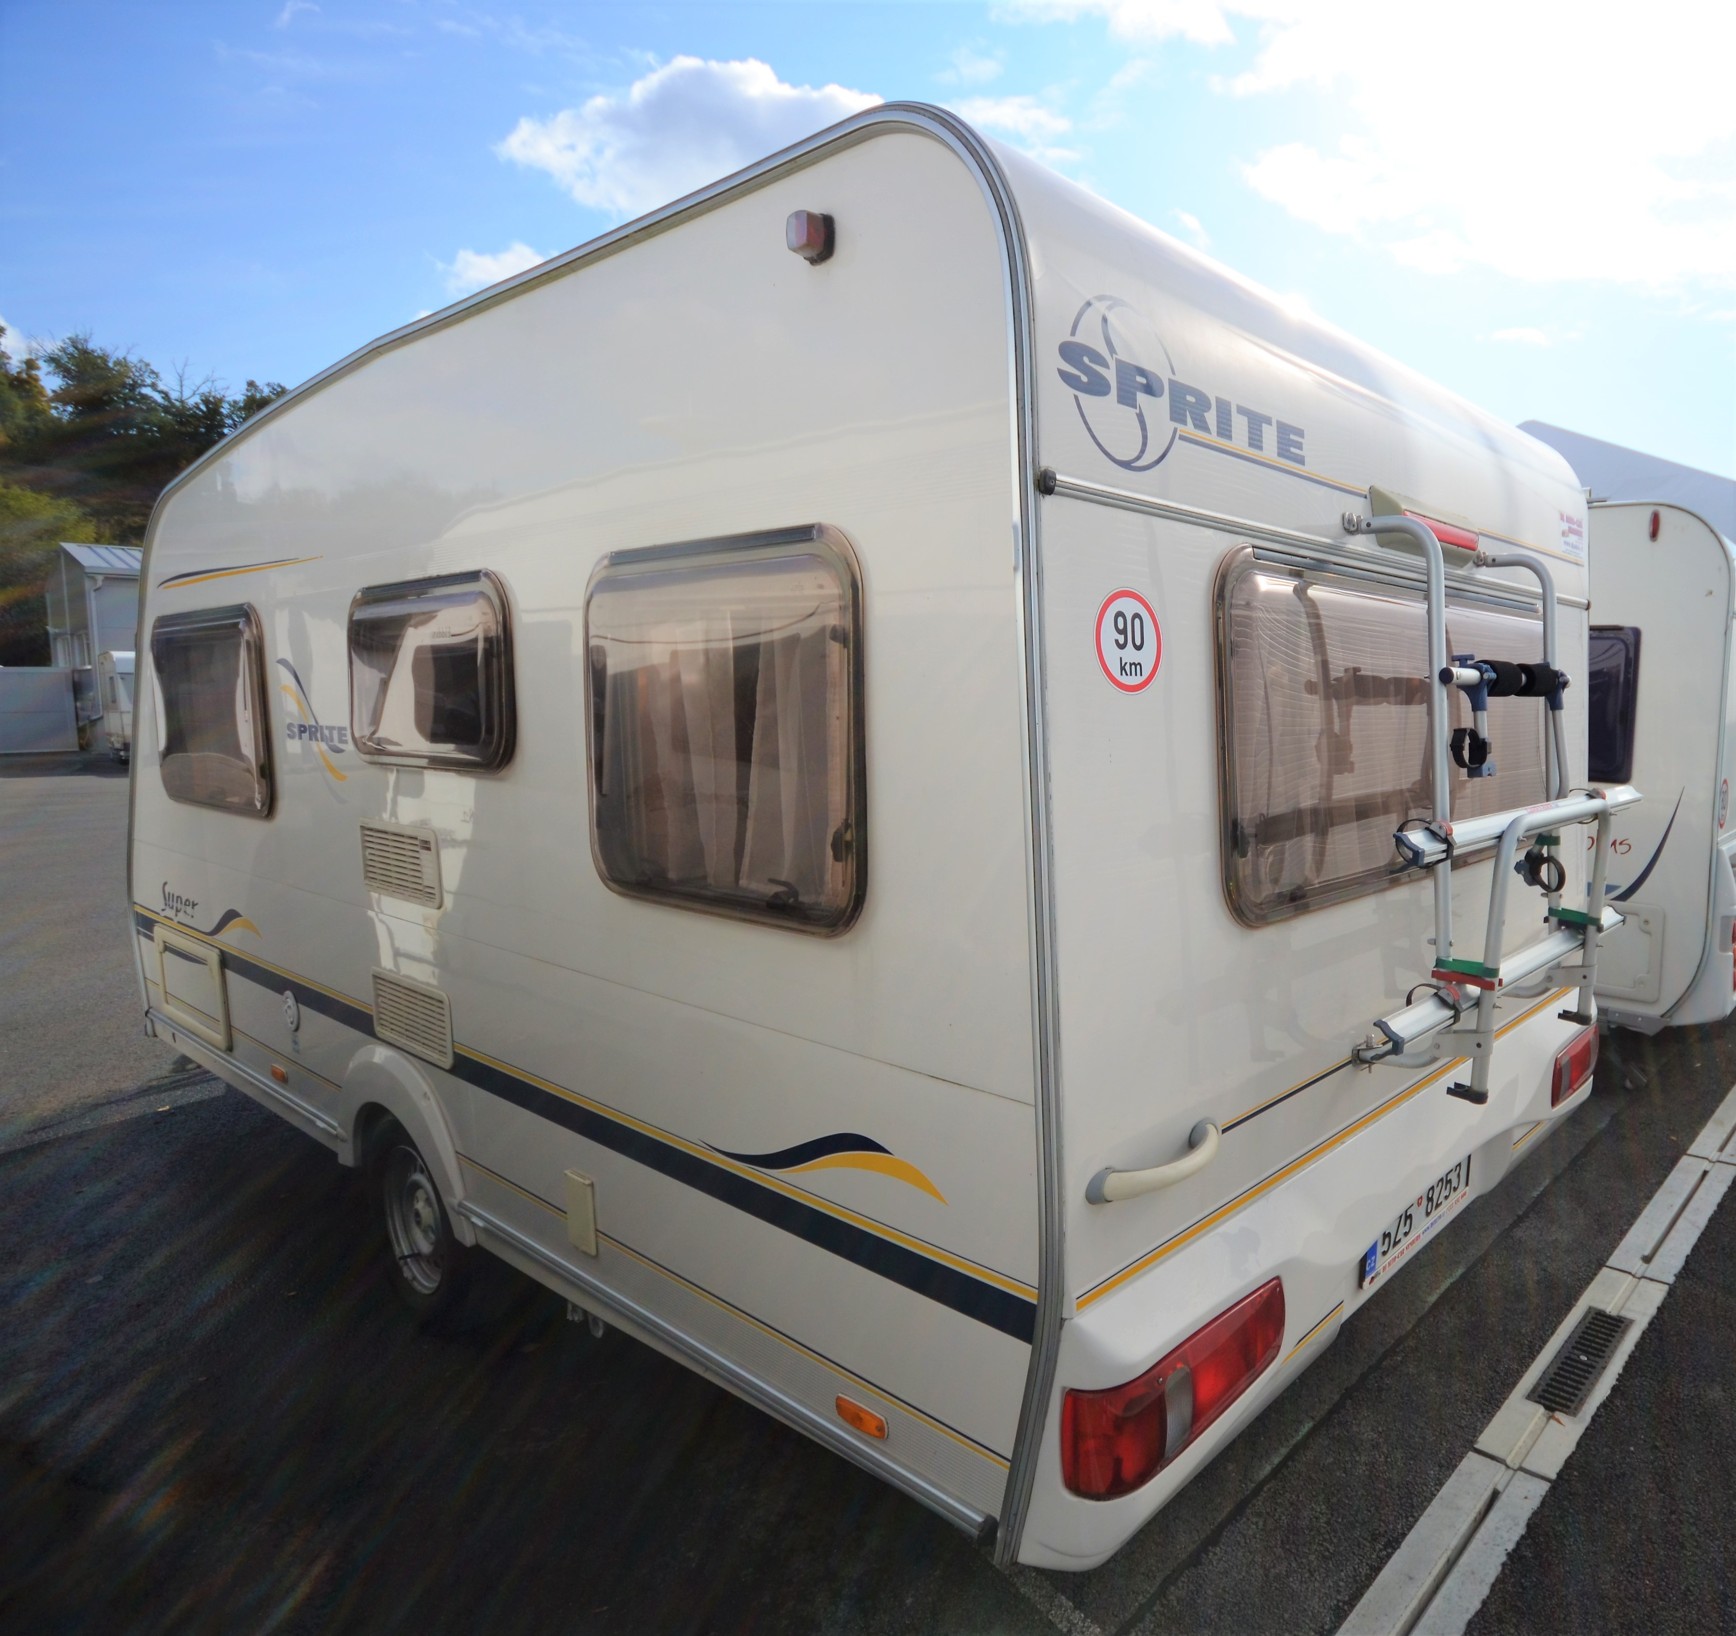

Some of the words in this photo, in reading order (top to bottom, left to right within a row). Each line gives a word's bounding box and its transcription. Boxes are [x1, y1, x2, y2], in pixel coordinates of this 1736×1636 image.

[1056, 340, 1306, 467] SPRITE
[1113, 609, 1145, 652] 90
[1119, 656, 1143, 677] km
[286, 722, 349, 745] SPRITE
[160, 881, 199, 919] Super
[1381, 1203, 1414, 1257] 5Z5
[1425, 1161, 1462, 1218] 8253
[1366, 1255, 1376, 1273] CZ
